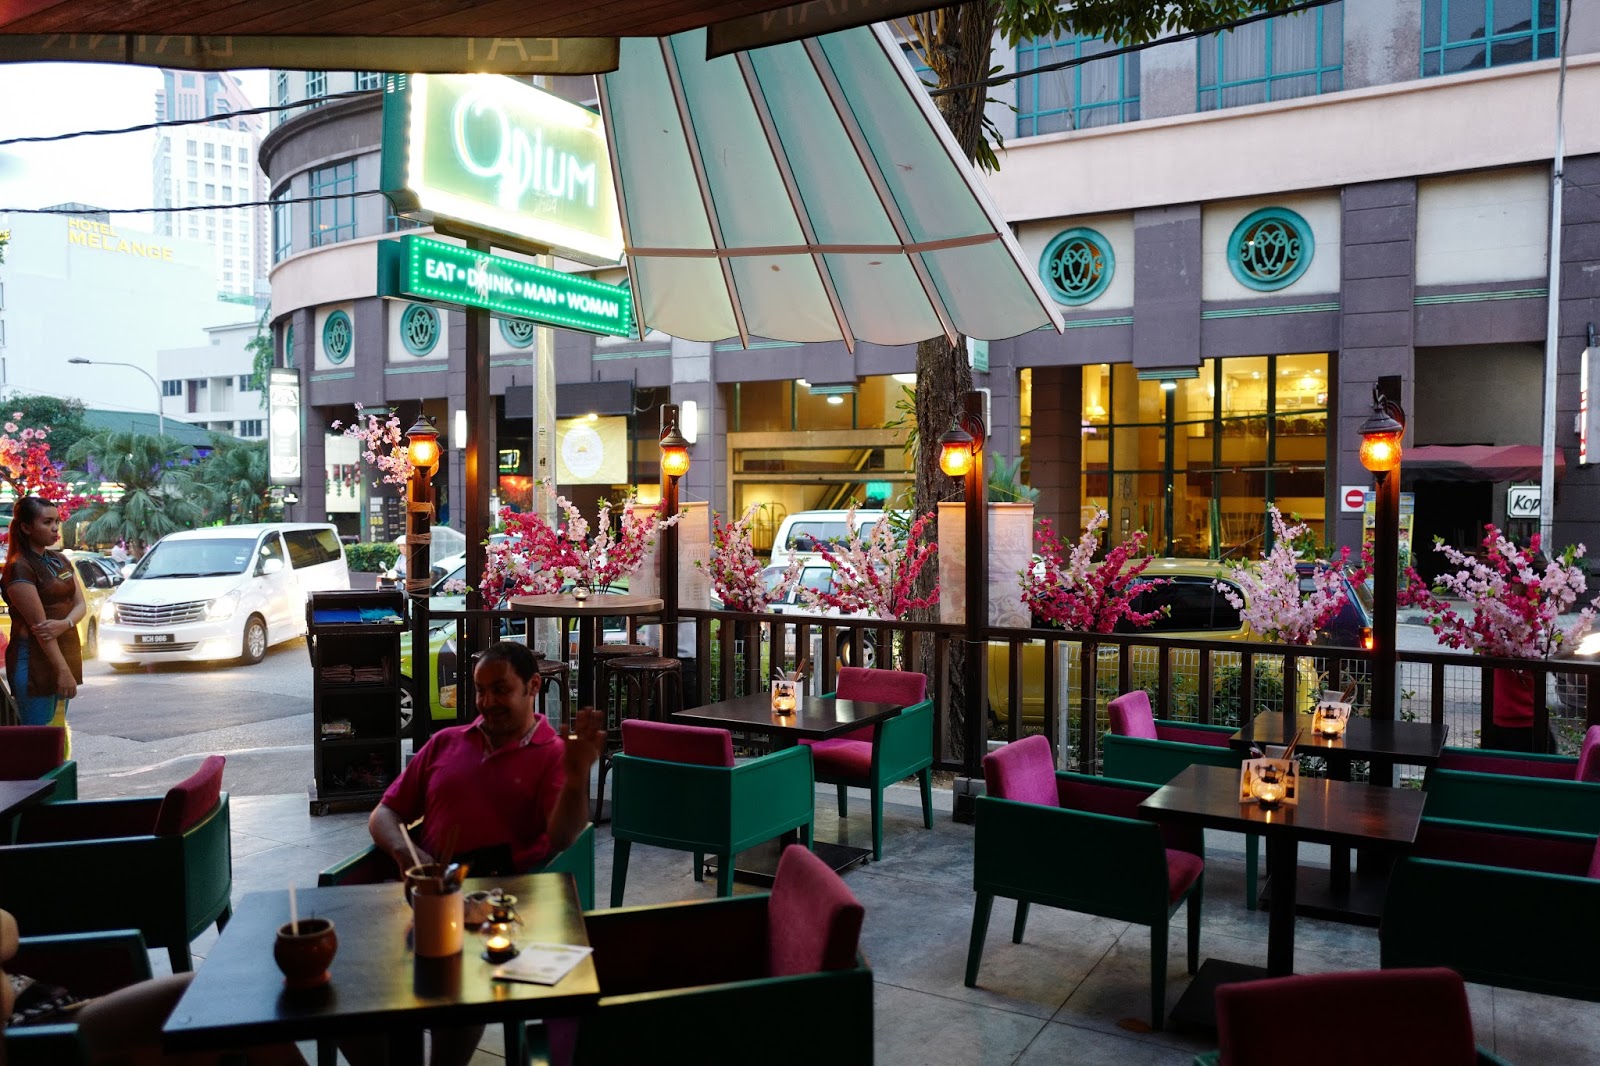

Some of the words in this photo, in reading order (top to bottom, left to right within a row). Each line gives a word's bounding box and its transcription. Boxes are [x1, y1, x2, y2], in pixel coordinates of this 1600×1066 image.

[68, 217, 118, 237] HOTEL
[68, 230, 174, 261] MELANGE
[425, 258, 456, 283] EAT
[467, 268, 515, 297] DRINK
[523, 281, 557, 306] MAN
[566, 292, 619, 319] WOMAN
